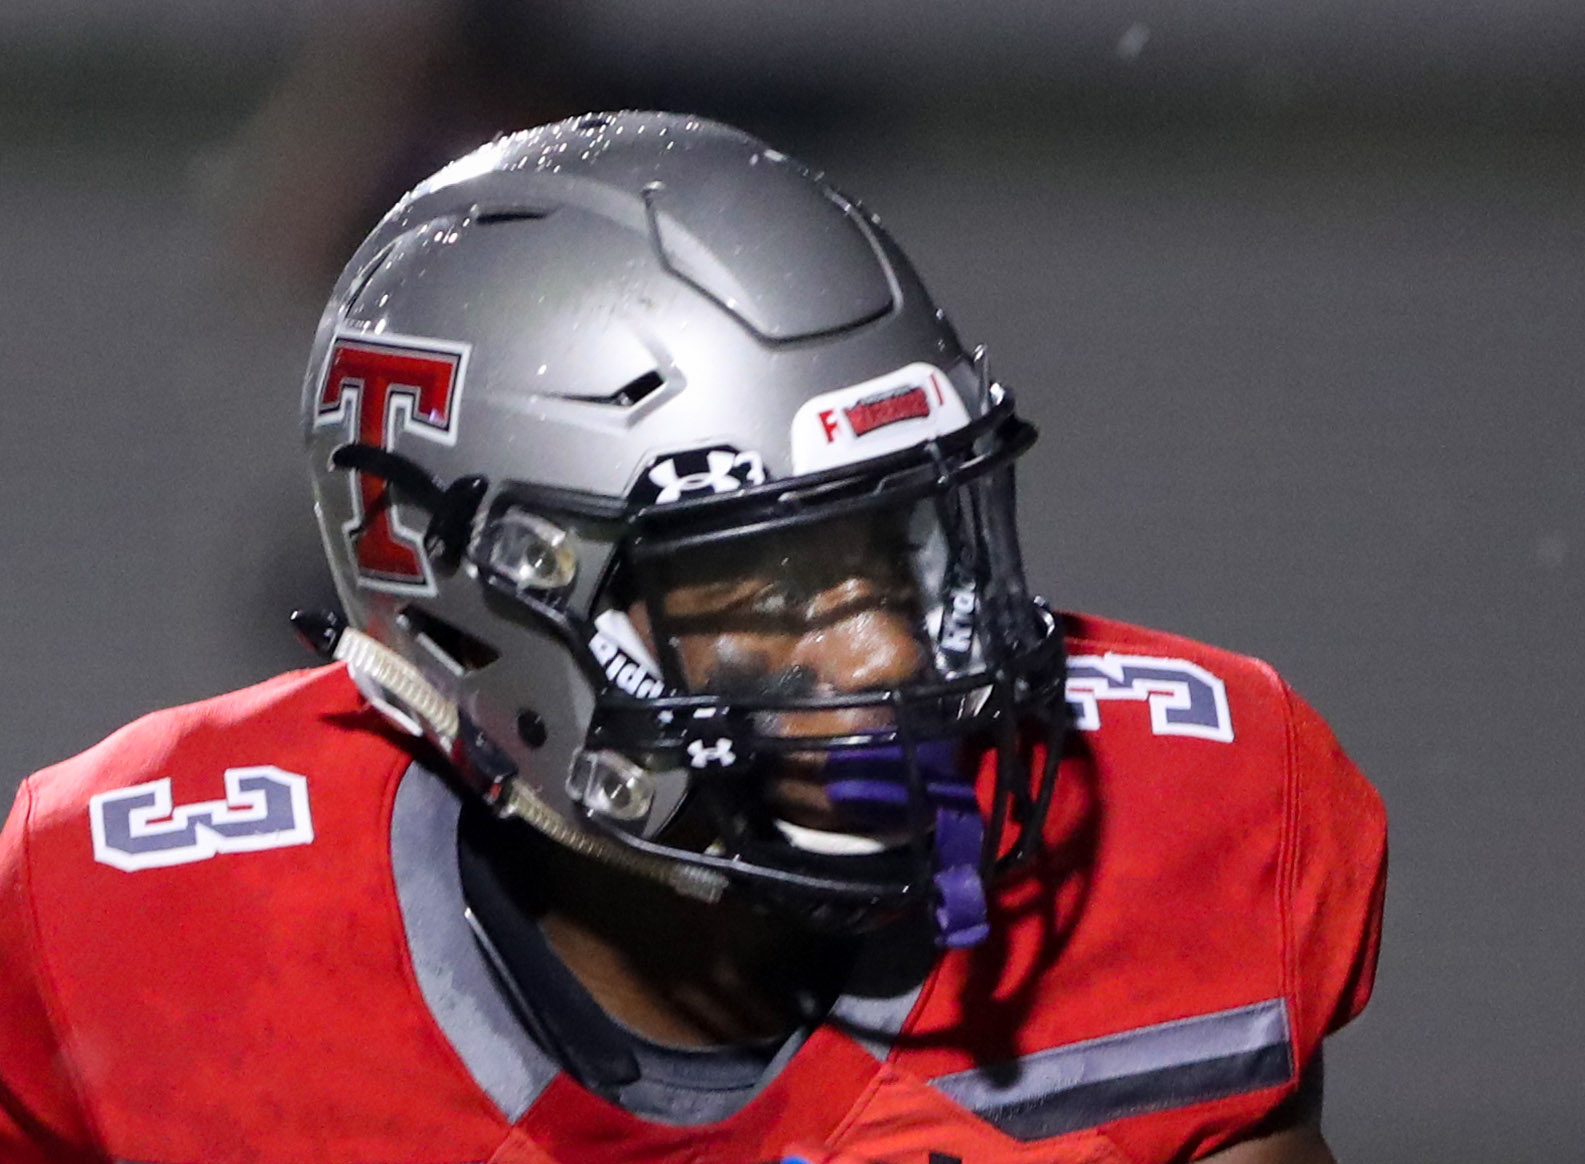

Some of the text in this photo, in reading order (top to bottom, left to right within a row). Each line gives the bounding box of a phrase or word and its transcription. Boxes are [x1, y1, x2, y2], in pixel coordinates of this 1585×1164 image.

[314, 327, 471, 597] T
[1065, 651, 1235, 743] 3
[89, 765, 314, 873] 3
